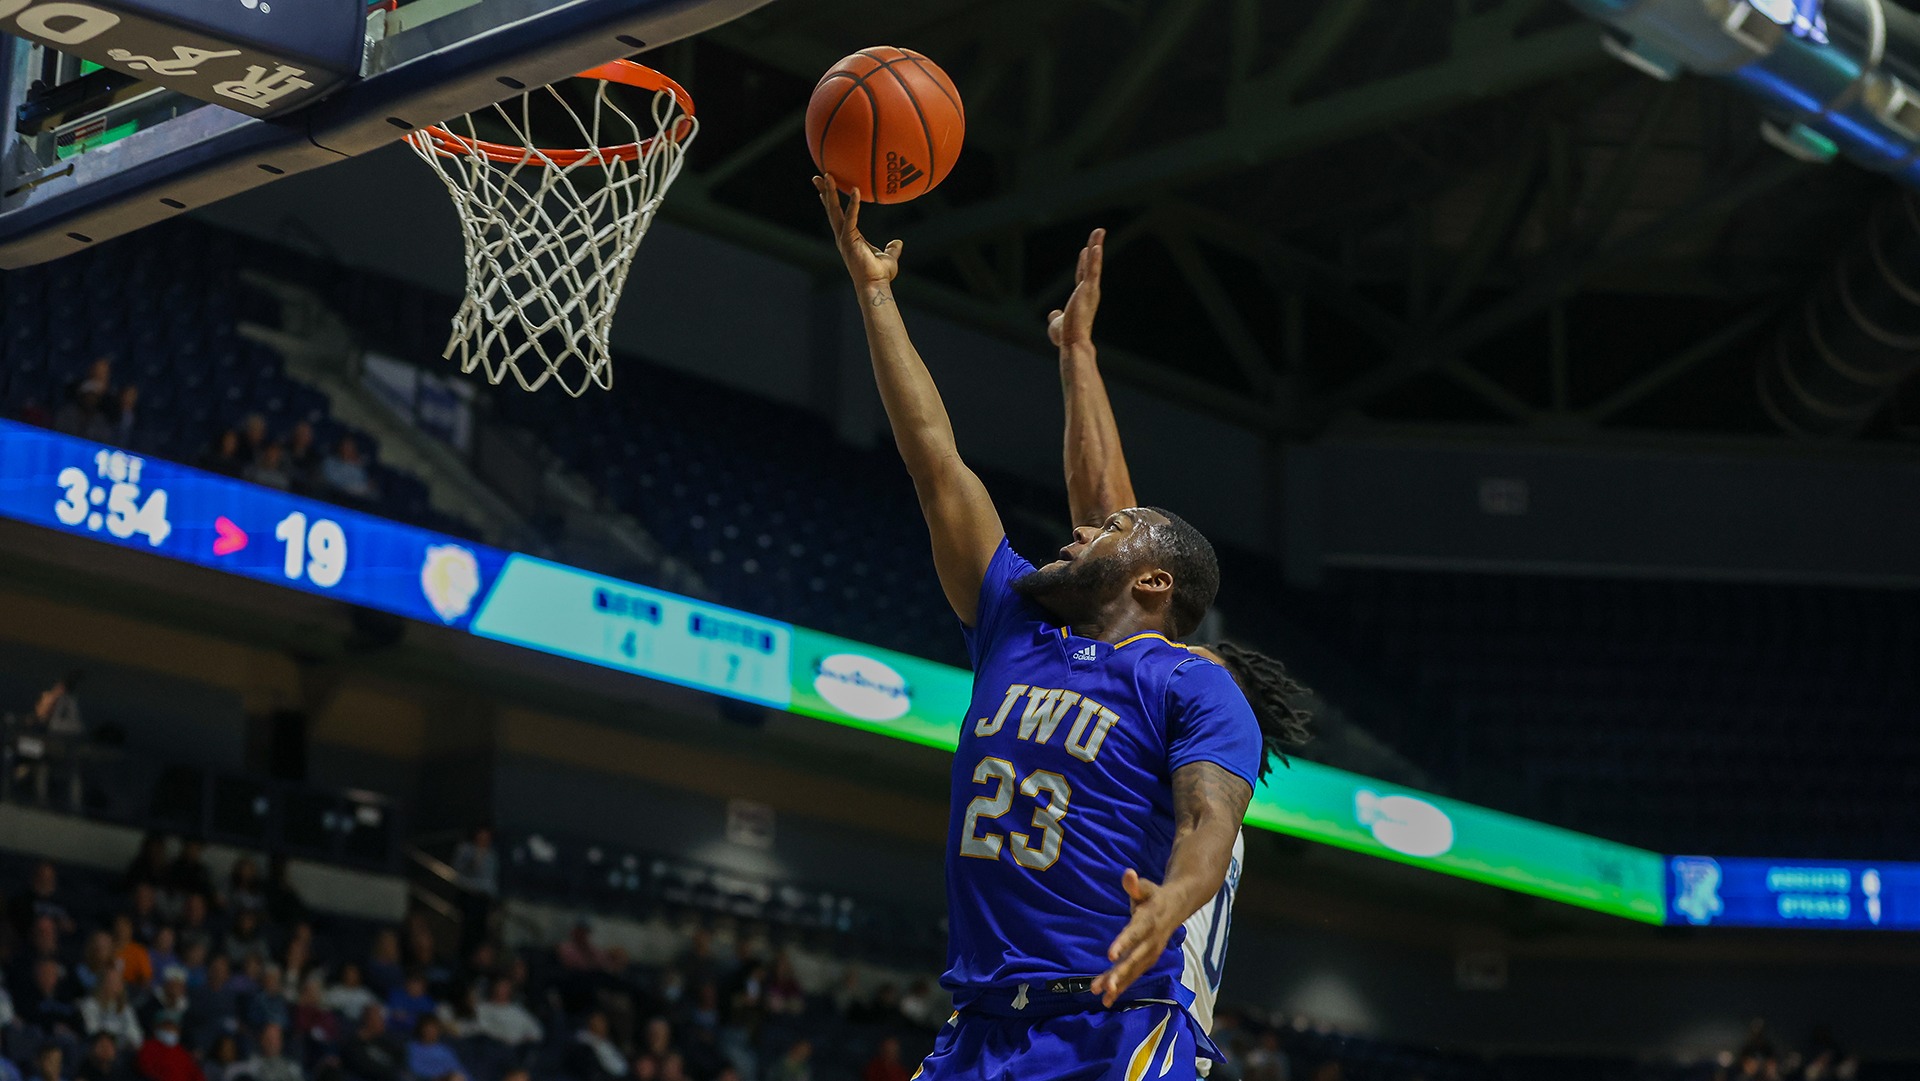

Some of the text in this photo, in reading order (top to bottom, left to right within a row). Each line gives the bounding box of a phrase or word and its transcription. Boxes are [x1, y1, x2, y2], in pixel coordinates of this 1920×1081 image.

[886, 151, 899, 194] adidas
[55, 467, 171, 547] 3:54
[276, 511, 347, 588] 19
[1073, 653, 1096, 661] adidas
[974, 684, 1120, 763] JWU
[960, 756, 1072, 871] 23
